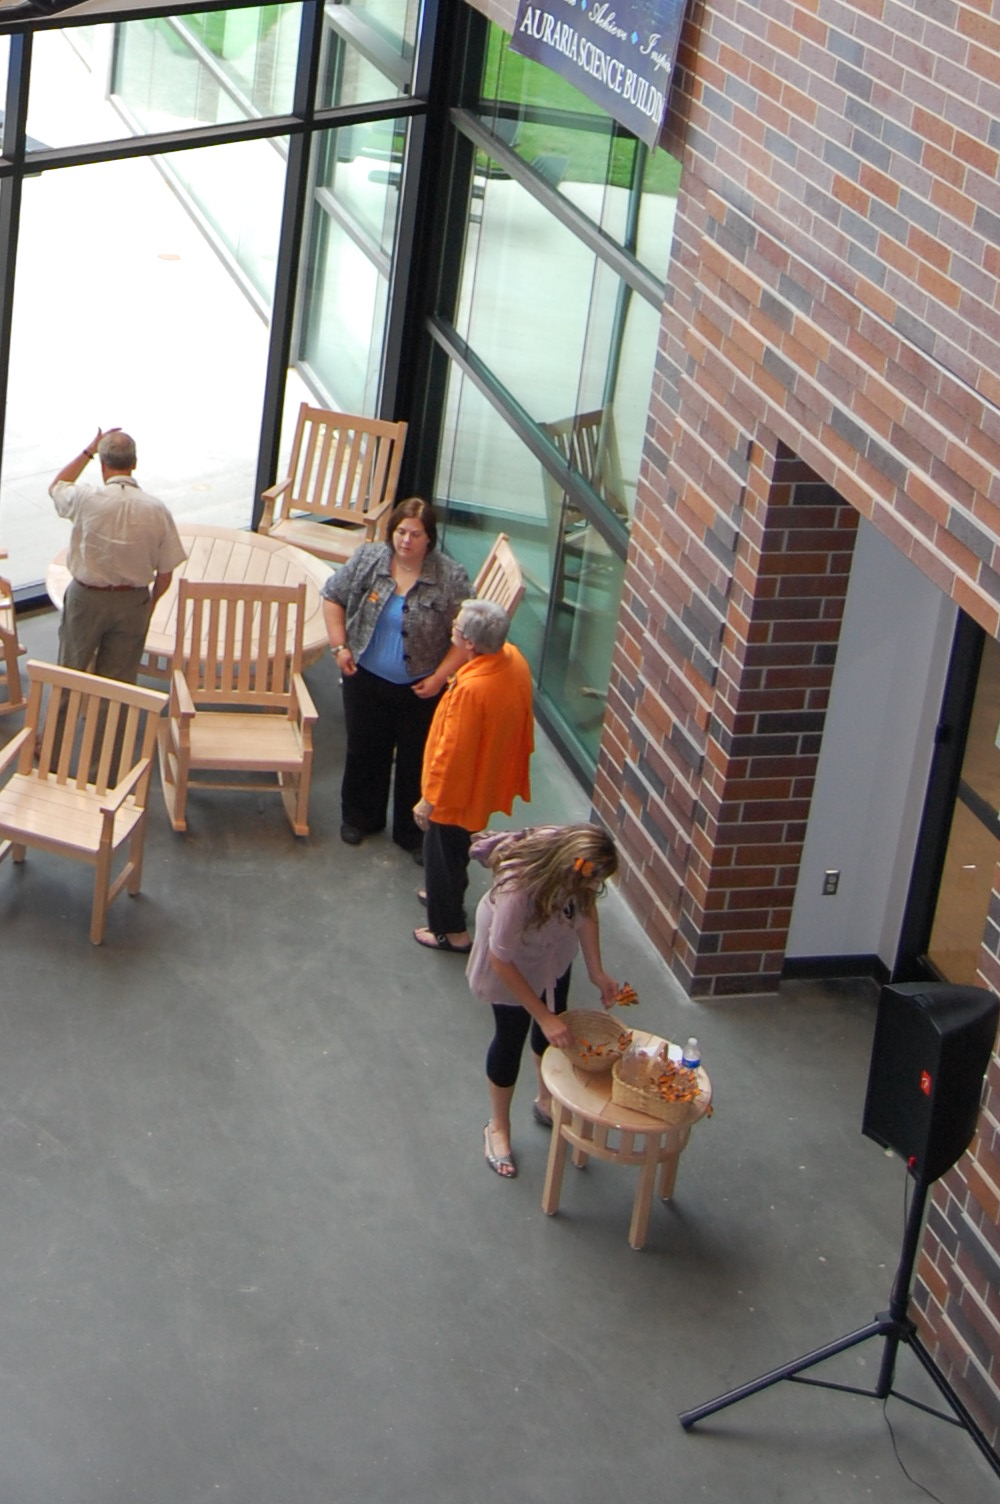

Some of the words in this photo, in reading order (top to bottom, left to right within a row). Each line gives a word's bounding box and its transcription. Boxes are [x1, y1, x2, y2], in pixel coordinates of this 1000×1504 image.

[519, 6, 578, 62] AURARIA
[577, 37, 625, 94] SCIENCE
[588, 2, 628, 41] Achieve
